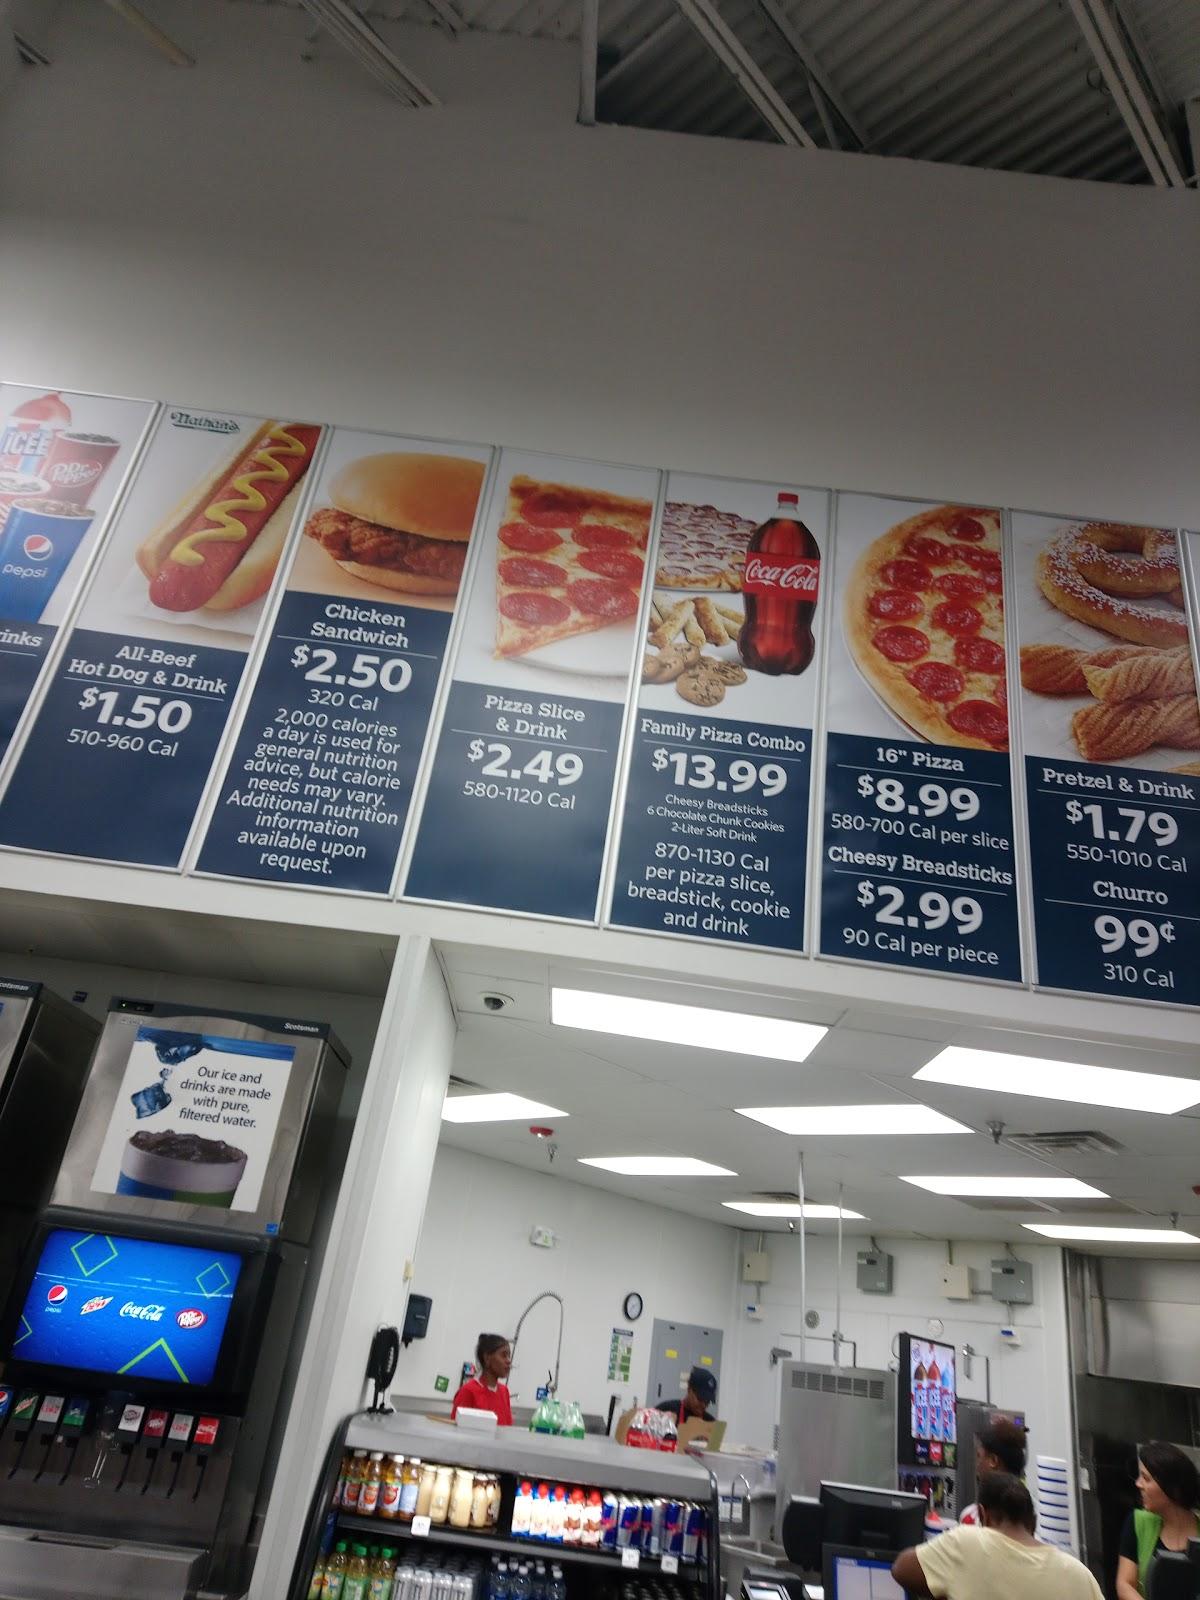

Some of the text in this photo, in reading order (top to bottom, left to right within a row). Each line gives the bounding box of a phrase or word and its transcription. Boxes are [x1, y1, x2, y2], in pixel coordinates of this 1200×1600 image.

[2, 563, 48, 579] pepsi
[746, 559, 818, 590] Coca-Cola
[325, 603, 406, 627] Chicken
[310, 622, 409, 648] Sandwich
[116, 646, 197, 668] All-Beef
[291, 644, 412, 692] $2.50
[68, 659, 227, 694] Hot Dog & Drink
[78, 686, 192, 733] $1.50
[308, 689, 378, 711] 320 Cal
[485, 694, 586, 722] Pizza Slice
[274, 708, 397, 738] 2,000 calories
[496, 717, 567, 740] & Drink
[641, 719, 805, 752] Family Pizza Combo
[67, 729, 178, 756] 510-960 Cal
[263, 725, 400, 754] a day is used for
[255, 742, 397, 772] general nutrition
[468, 738, 583, 785] $2.49
[912, 751, 964, 772] Pizza
[243, 757, 400, 790] advice, but calorie
[652, 747, 787, 797] $13.99
[1042, 768, 1195, 800] Pretzel & Drink
[227, 789, 399, 826] Additional nutrition
[248, 776, 385, 810] needs may vary.
[463, 781, 575, 810] 580-1120 Cal
[665, 794, 768, 816] Cheesy Breadsticks
[857, 774, 980, 821] $8.99
[255, 811, 359, 838] information
[647, 806, 784, 832] 6 Chocolate Chunk Cookies
[672, 822, 757, 843] 2-Liter Soft Drink
[831, 813, 1009, 850] 580-700 Cal per slice
[1066, 800, 1178, 847] $1.79
[238, 830, 366, 859] available upon
[655, 843, 769, 872] 870-1130 Cal
[1067, 843, 1188, 872] 550-1010 Cal
[260, 851, 332, 874] request.
[828, 846, 1012, 885] Cheesy Breadsticks
[646, 866, 775, 896] per pizza slice,
[1093, 880, 1169, 905] Churro
[628, 881, 790, 918] breadstick, cookie
[857, 880, 983, 935] $2.99
[663, 912, 749, 936] and drink
[1094, 915, 1176, 958] 99¢
[843, 927, 999, 965] 90 Cal per piece
[1104, 963, 1174, 988] 310 Cal
[284, 1022, 319, 1032] Scotsman
[180, 1079, 271, 1100] drinks are made
[198, 1066, 262, 1084] Our ice and
[179, 1107, 256, 1128] filtered water.
[193, 1096, 250, 1113] with pure,
